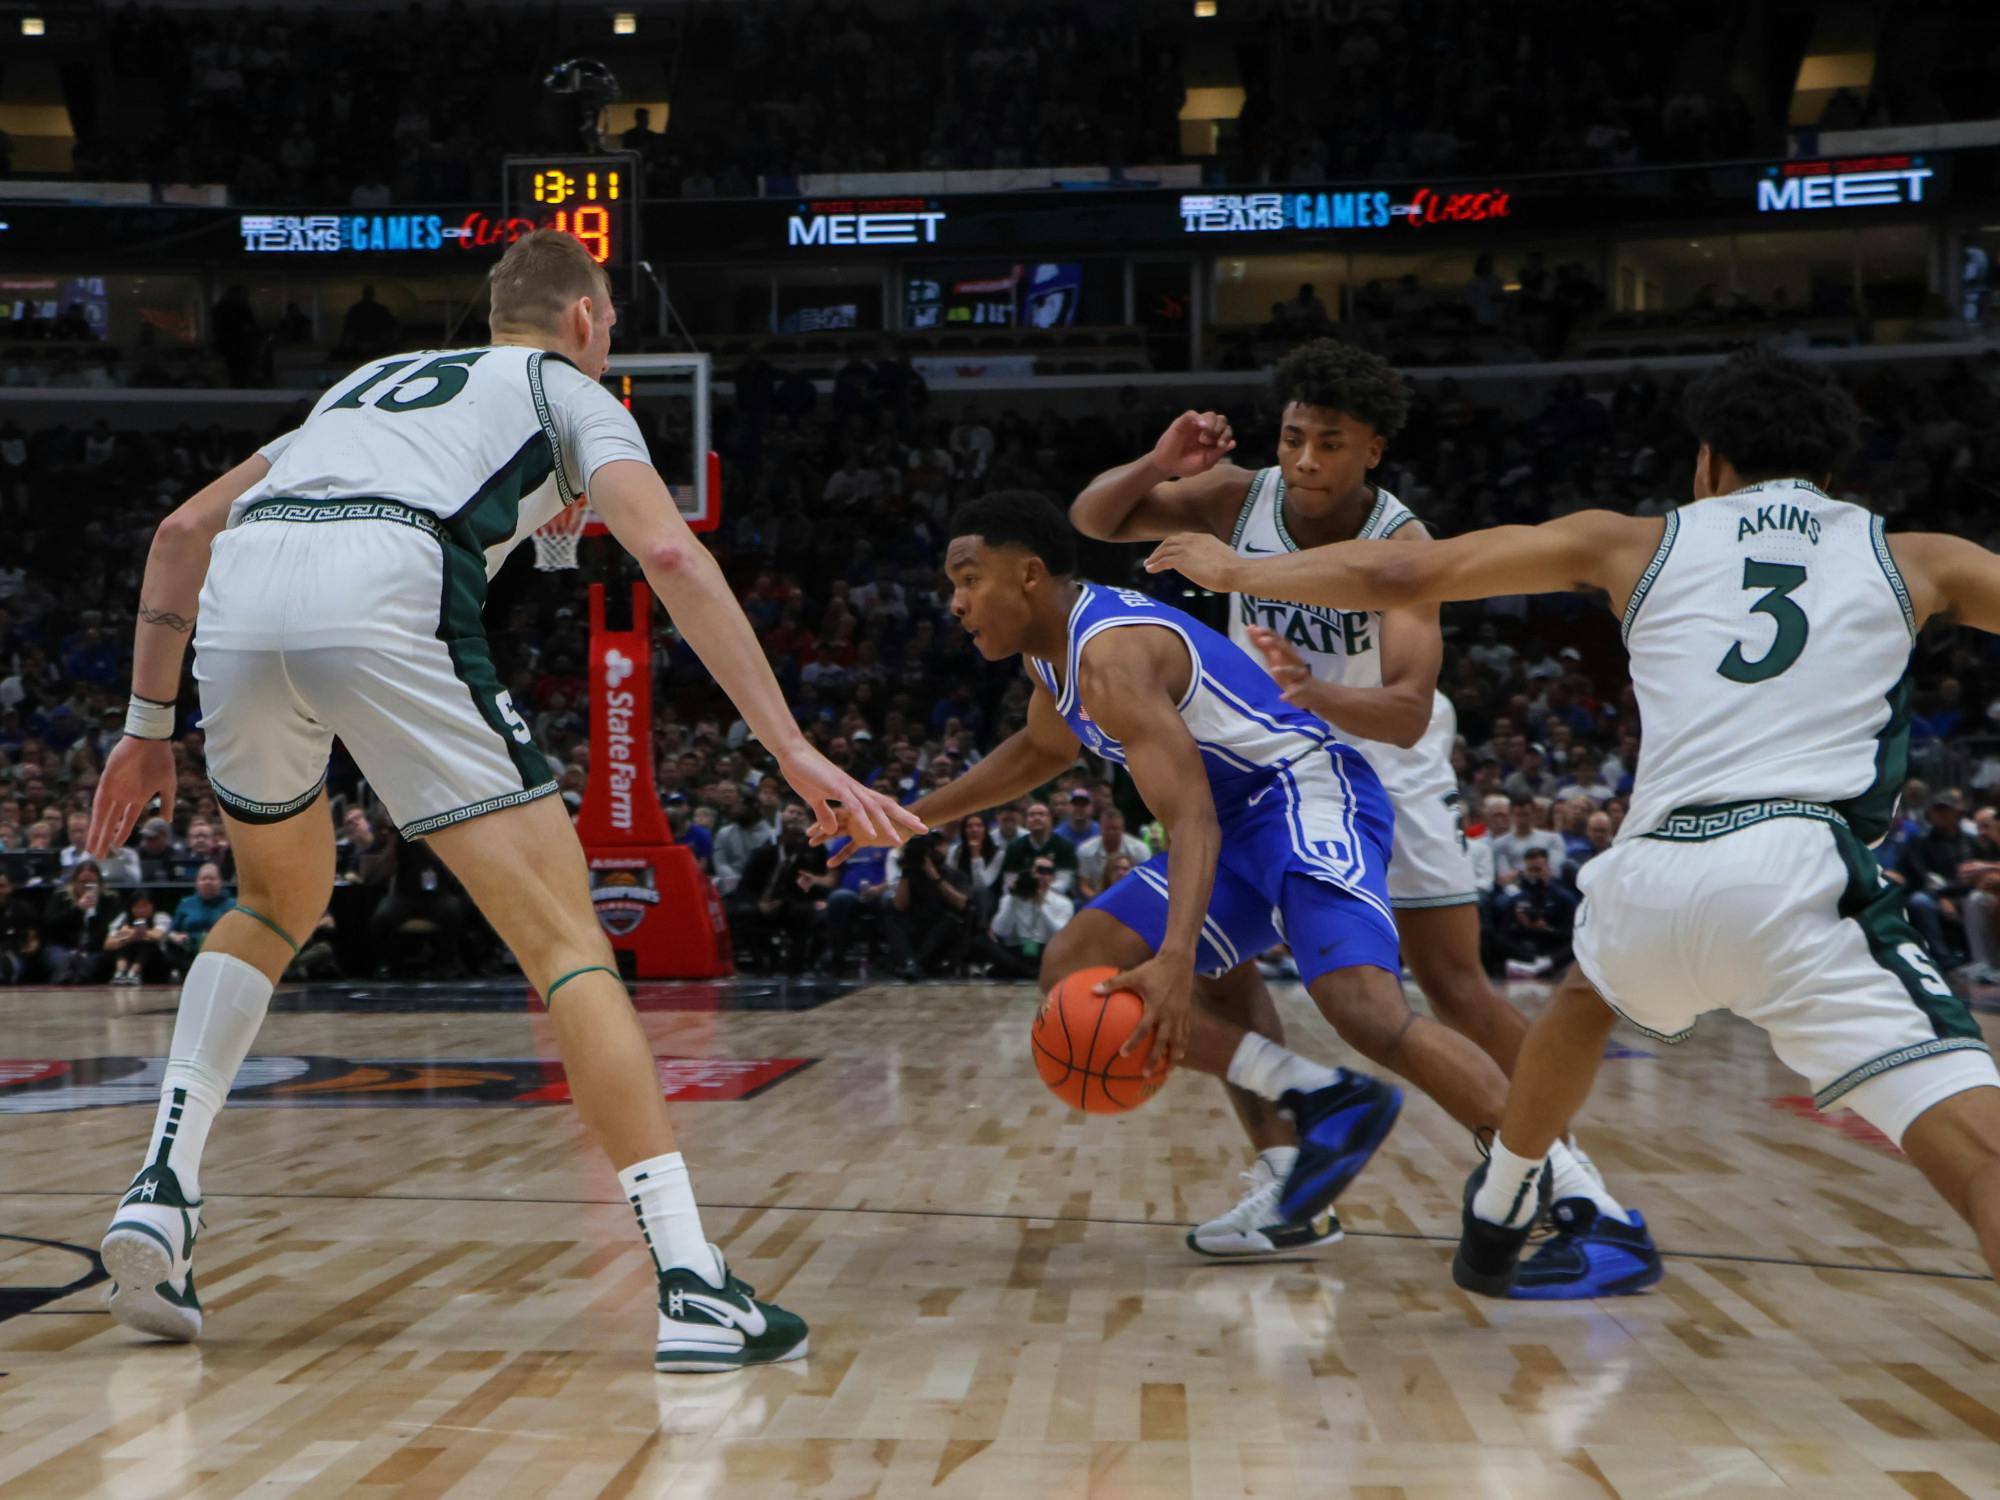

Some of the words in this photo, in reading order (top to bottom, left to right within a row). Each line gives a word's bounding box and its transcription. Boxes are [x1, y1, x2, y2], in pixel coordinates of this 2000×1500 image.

[533, 169, 619, 204] 13:11
[1756, 168, 1934, 212] MEET
[787, 211, 947, 247] MEET
[1181, 208, 1284, 232] TEAMS
[1294, 190, 1391, 230] GAMES
[240, 229, 341, 251] TEAMS
[351, 214, 443, 251] GAMES
[319, 350, 492, 416] 15
[1737, 503, 1822, 546] AKINS
[1716, 556, 1809, 684] 3
[495, 689, 532, 745] S
[1896, 941, 1953, 997] S
